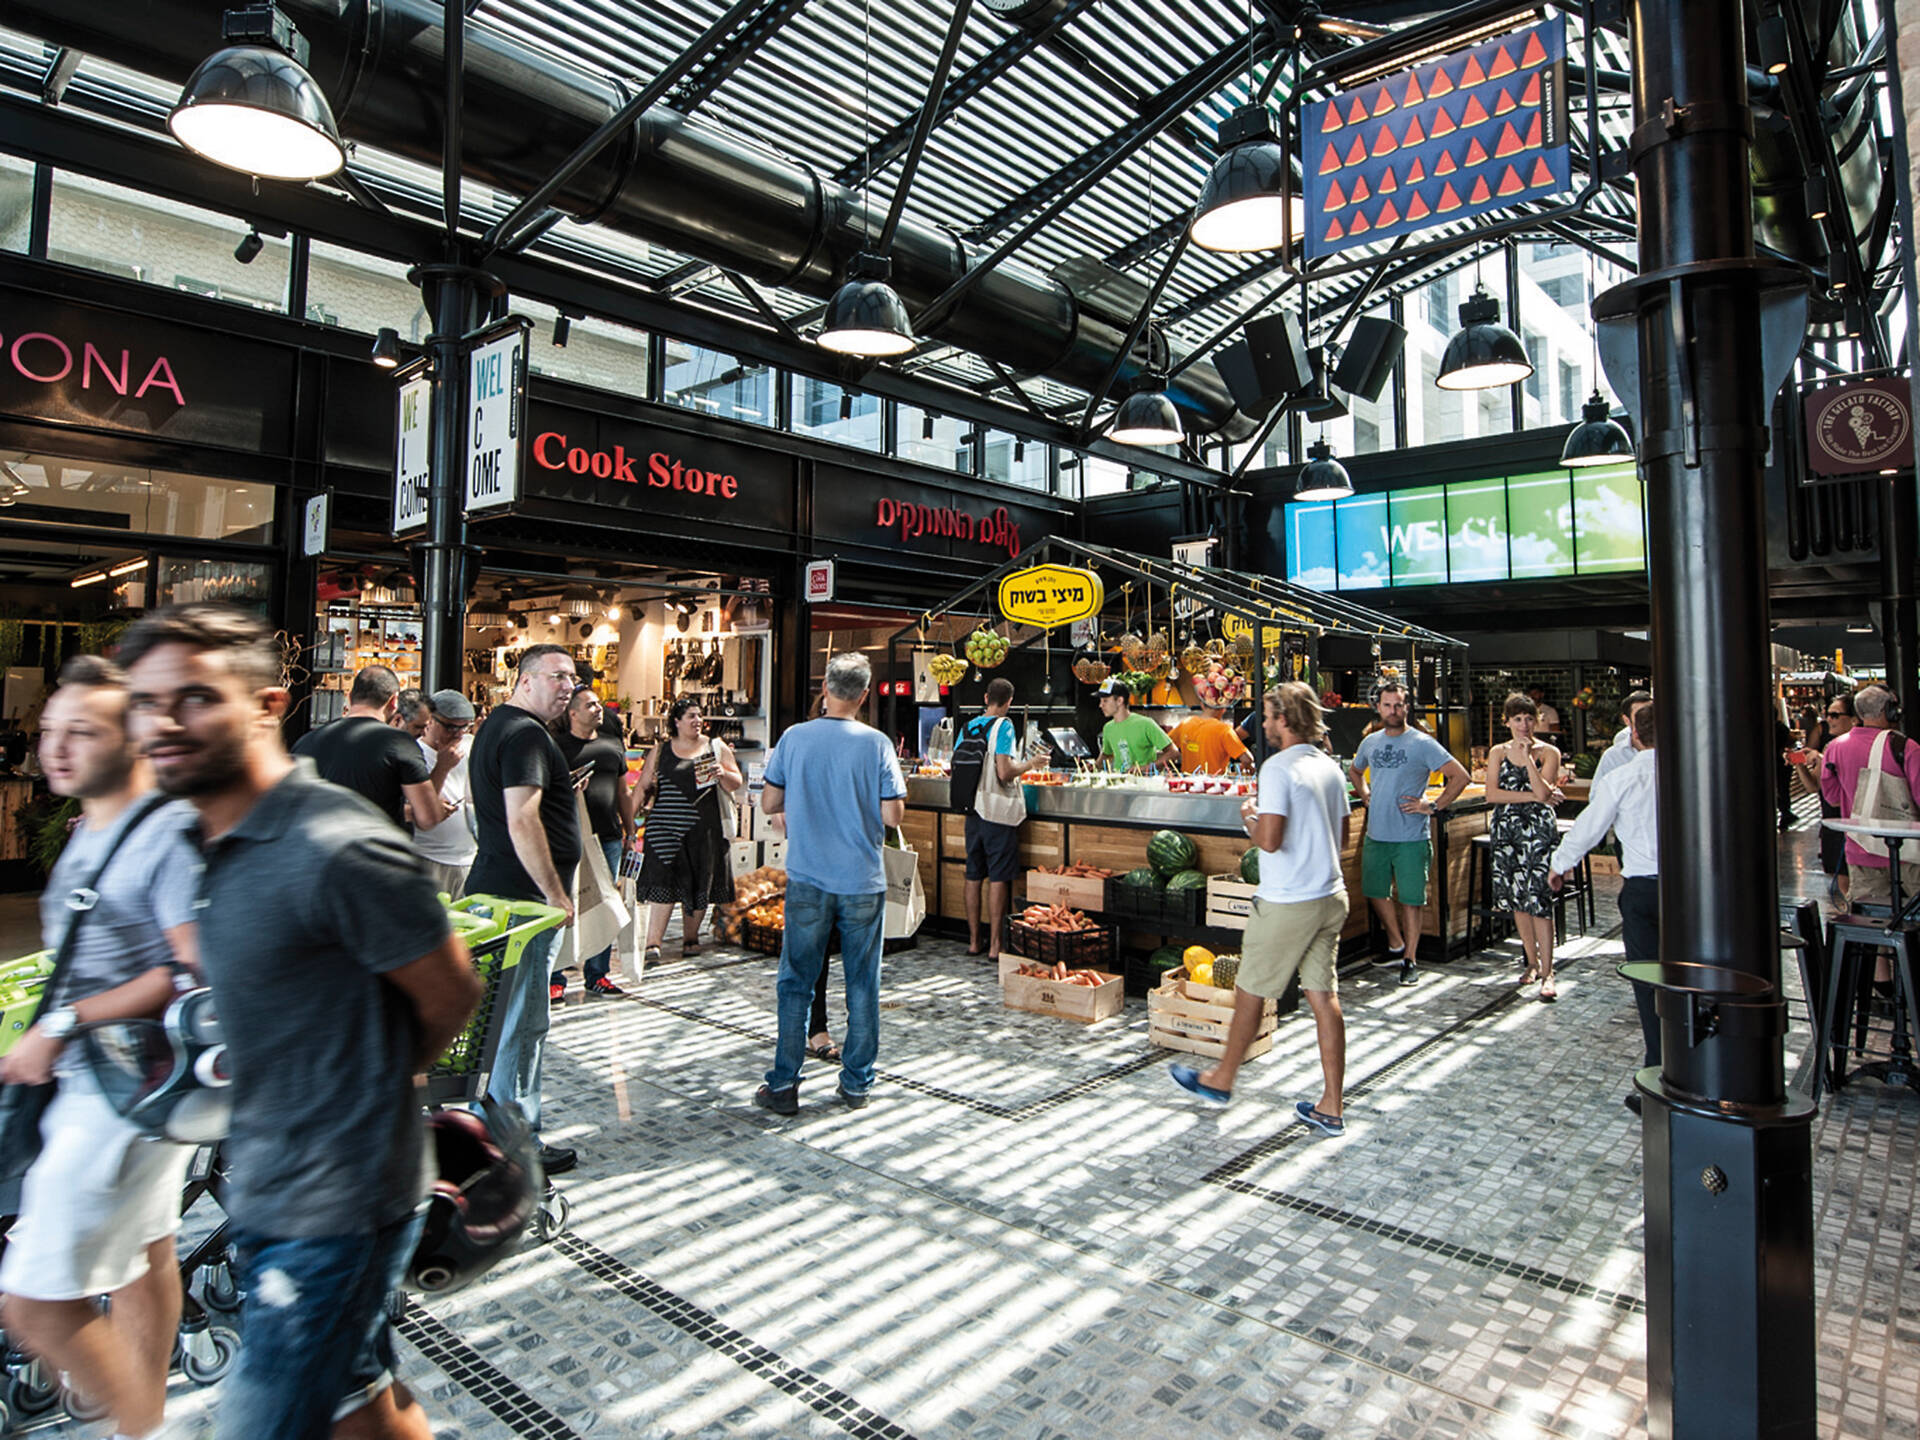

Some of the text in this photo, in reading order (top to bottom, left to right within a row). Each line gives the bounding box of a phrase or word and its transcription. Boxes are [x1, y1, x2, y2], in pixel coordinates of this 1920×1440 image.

[0, 330, 186, 406] ONA
[476, 352, 504, 401] WEL
[403, 389, 418, 433] WE
[474, 406, 483, 449] C
[472, 448, 502, 498] OME
[533, 432, 738, 499] Cook Store
[877, 497, 1021, 559] עולם הממתקים
[1010, 587, 1084, 608] מיצי בשוק
